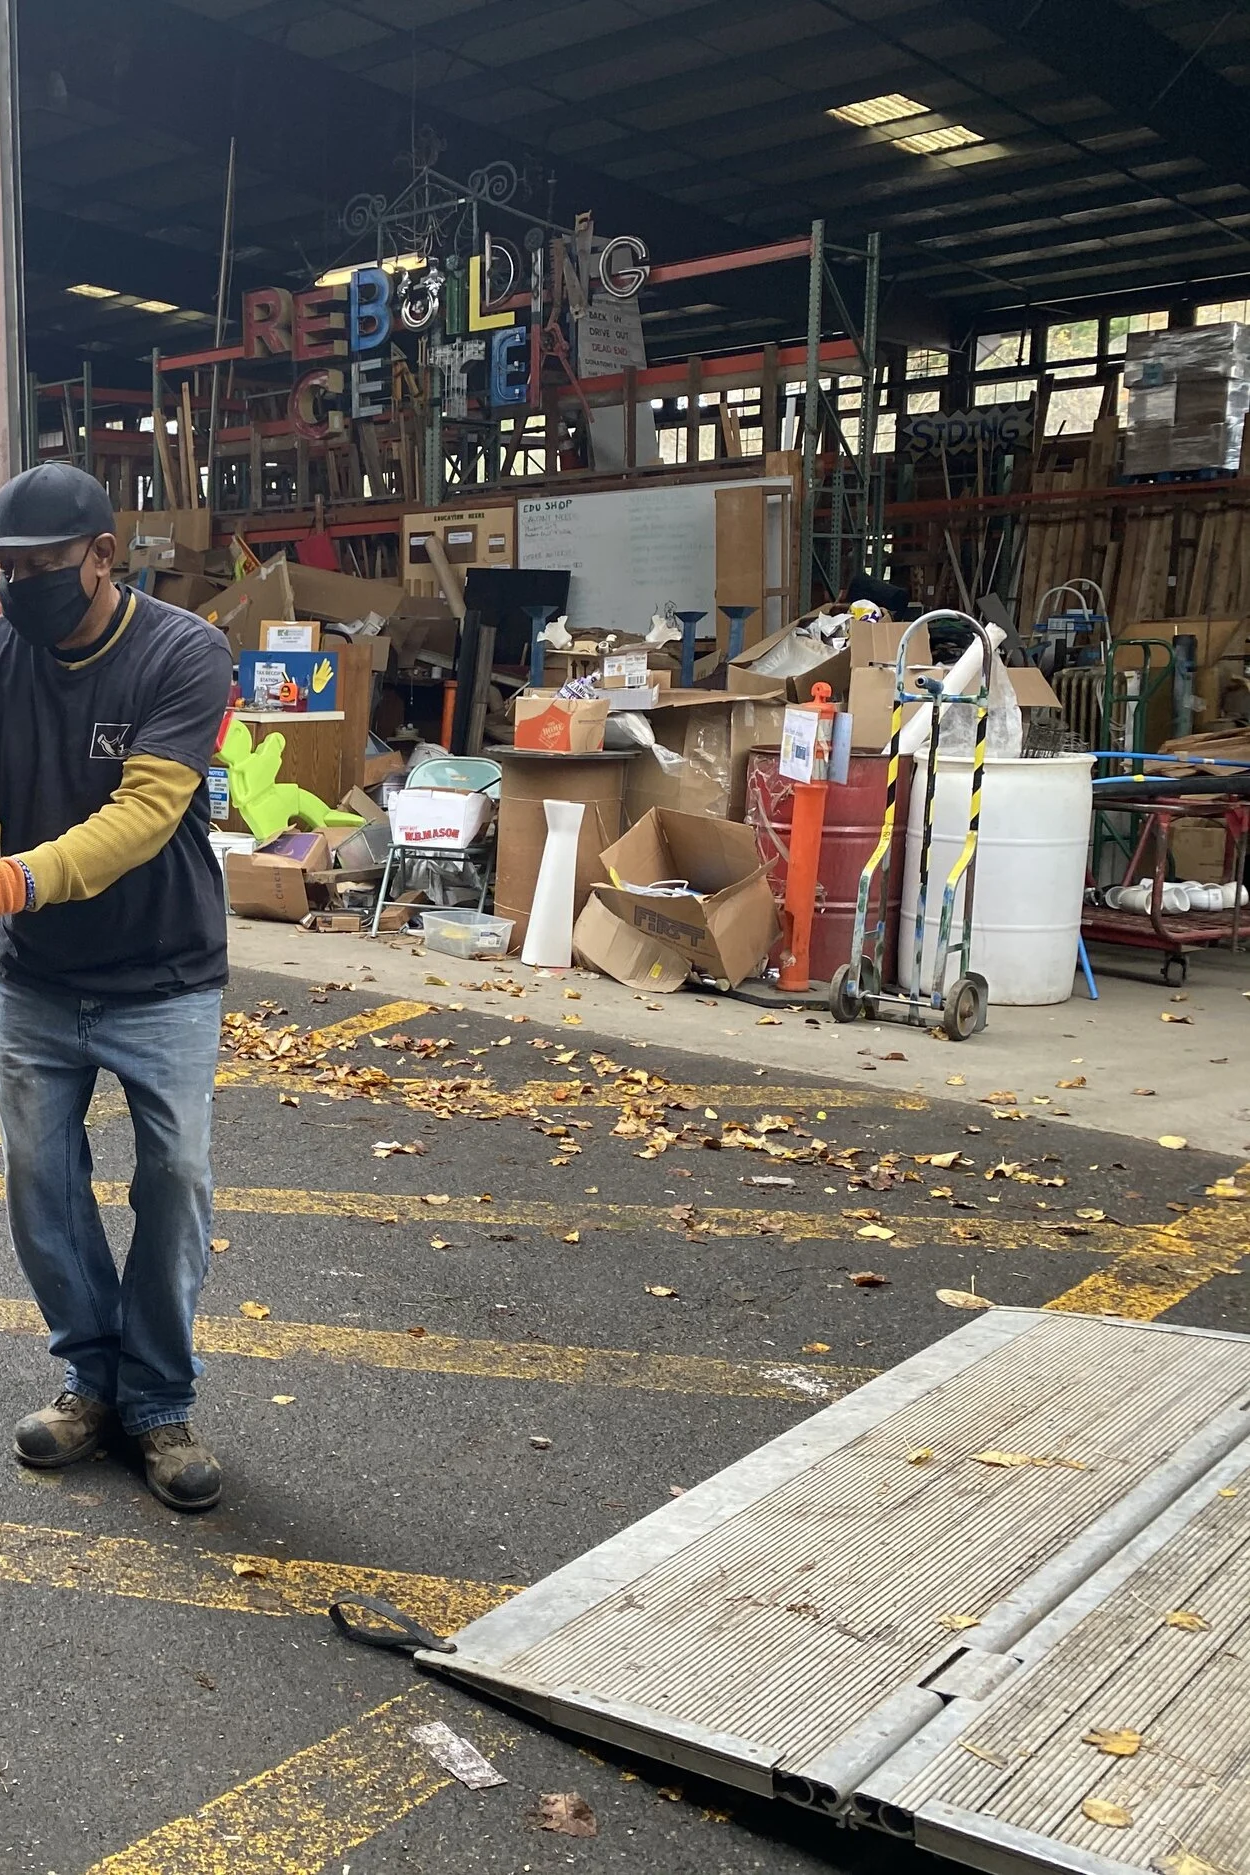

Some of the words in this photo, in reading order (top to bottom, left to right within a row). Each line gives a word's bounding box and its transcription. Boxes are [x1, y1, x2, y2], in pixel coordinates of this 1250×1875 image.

[242, 211, 651, 362] REBUILDING
[589, 311, 607, 321] BACK
[613, 314, 622, 323] IN
[589, 327, 610, 338] DRIVE
[615, 331, 629, 340] OUT
[591, 343, 611, 353] DEAD
[614, 346, 628, 356] END
[288, 323, 593, 440] CENTER
[910, 416, 1021, 453] SIDING
[523, 504, 541, 513] EDU
[545, 499, 572, 510] SHOP
[634, 904, 706, 948] FIRST
